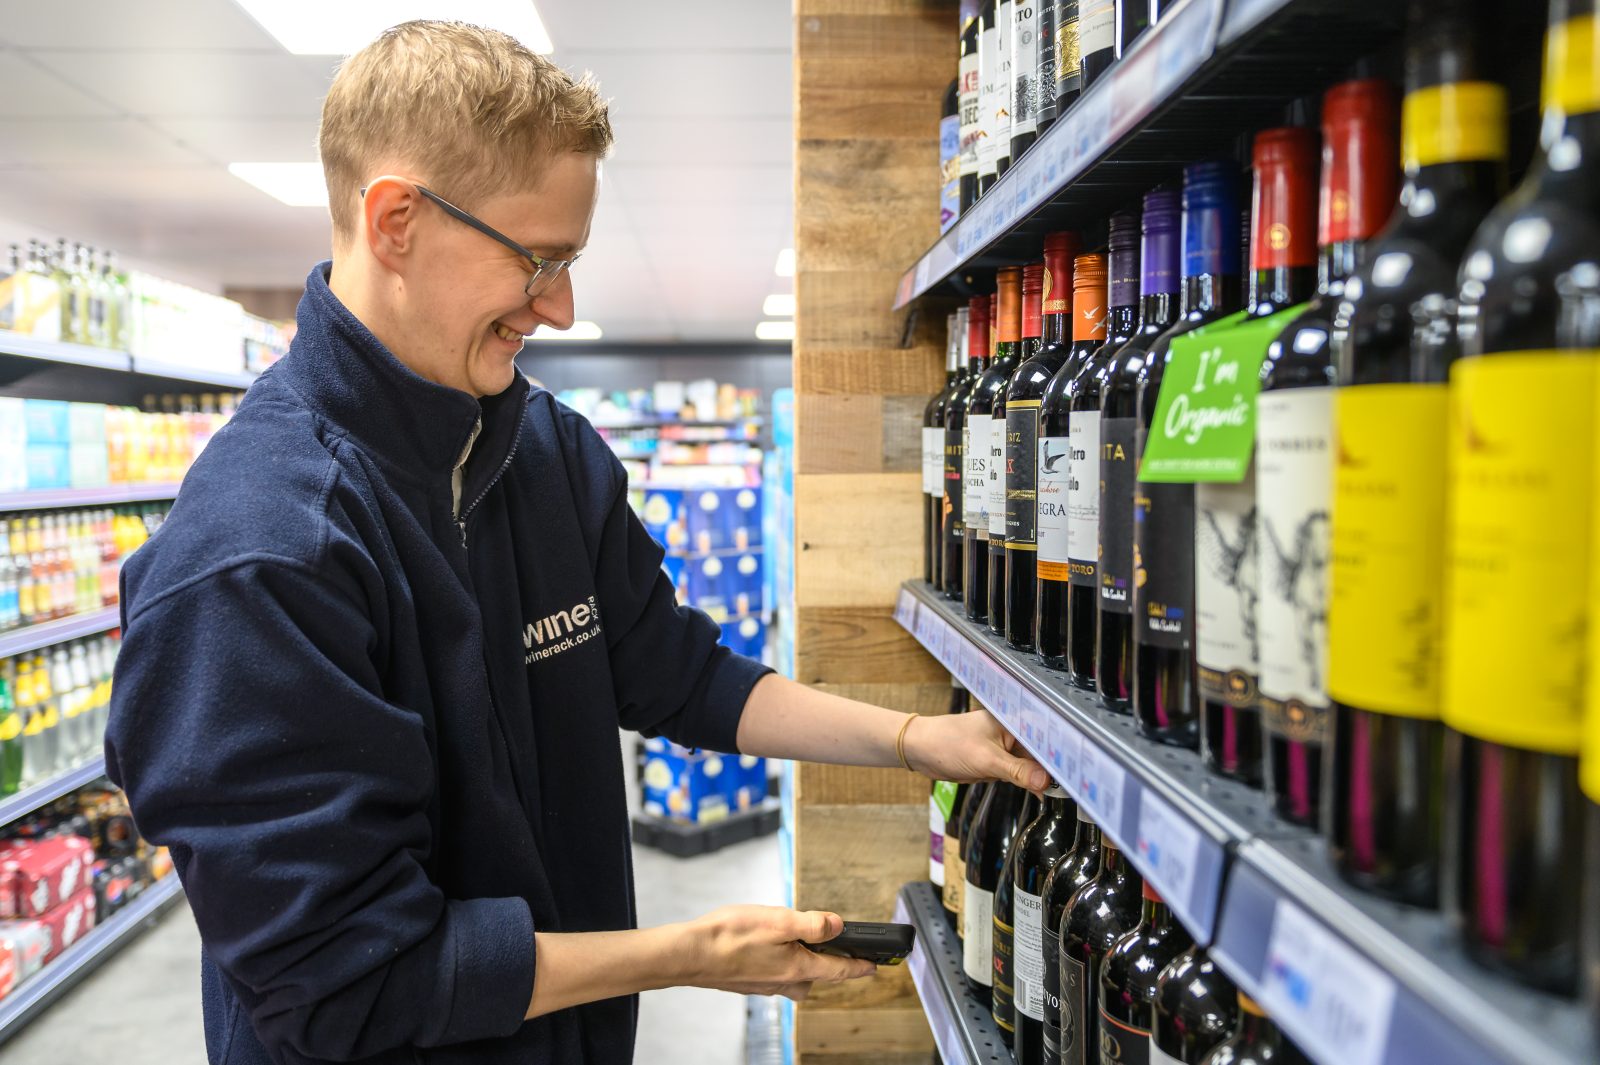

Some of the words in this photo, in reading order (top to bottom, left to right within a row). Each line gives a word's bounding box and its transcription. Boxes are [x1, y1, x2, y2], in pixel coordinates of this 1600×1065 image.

[1192, 346, 1239, 393] I'm
[1164, 393, 1249, 445] Organic
[1071, 563, 1094, 575] TORO
[522, 603, 591, 649] wine
[587, 595, 599, 620] RACK
